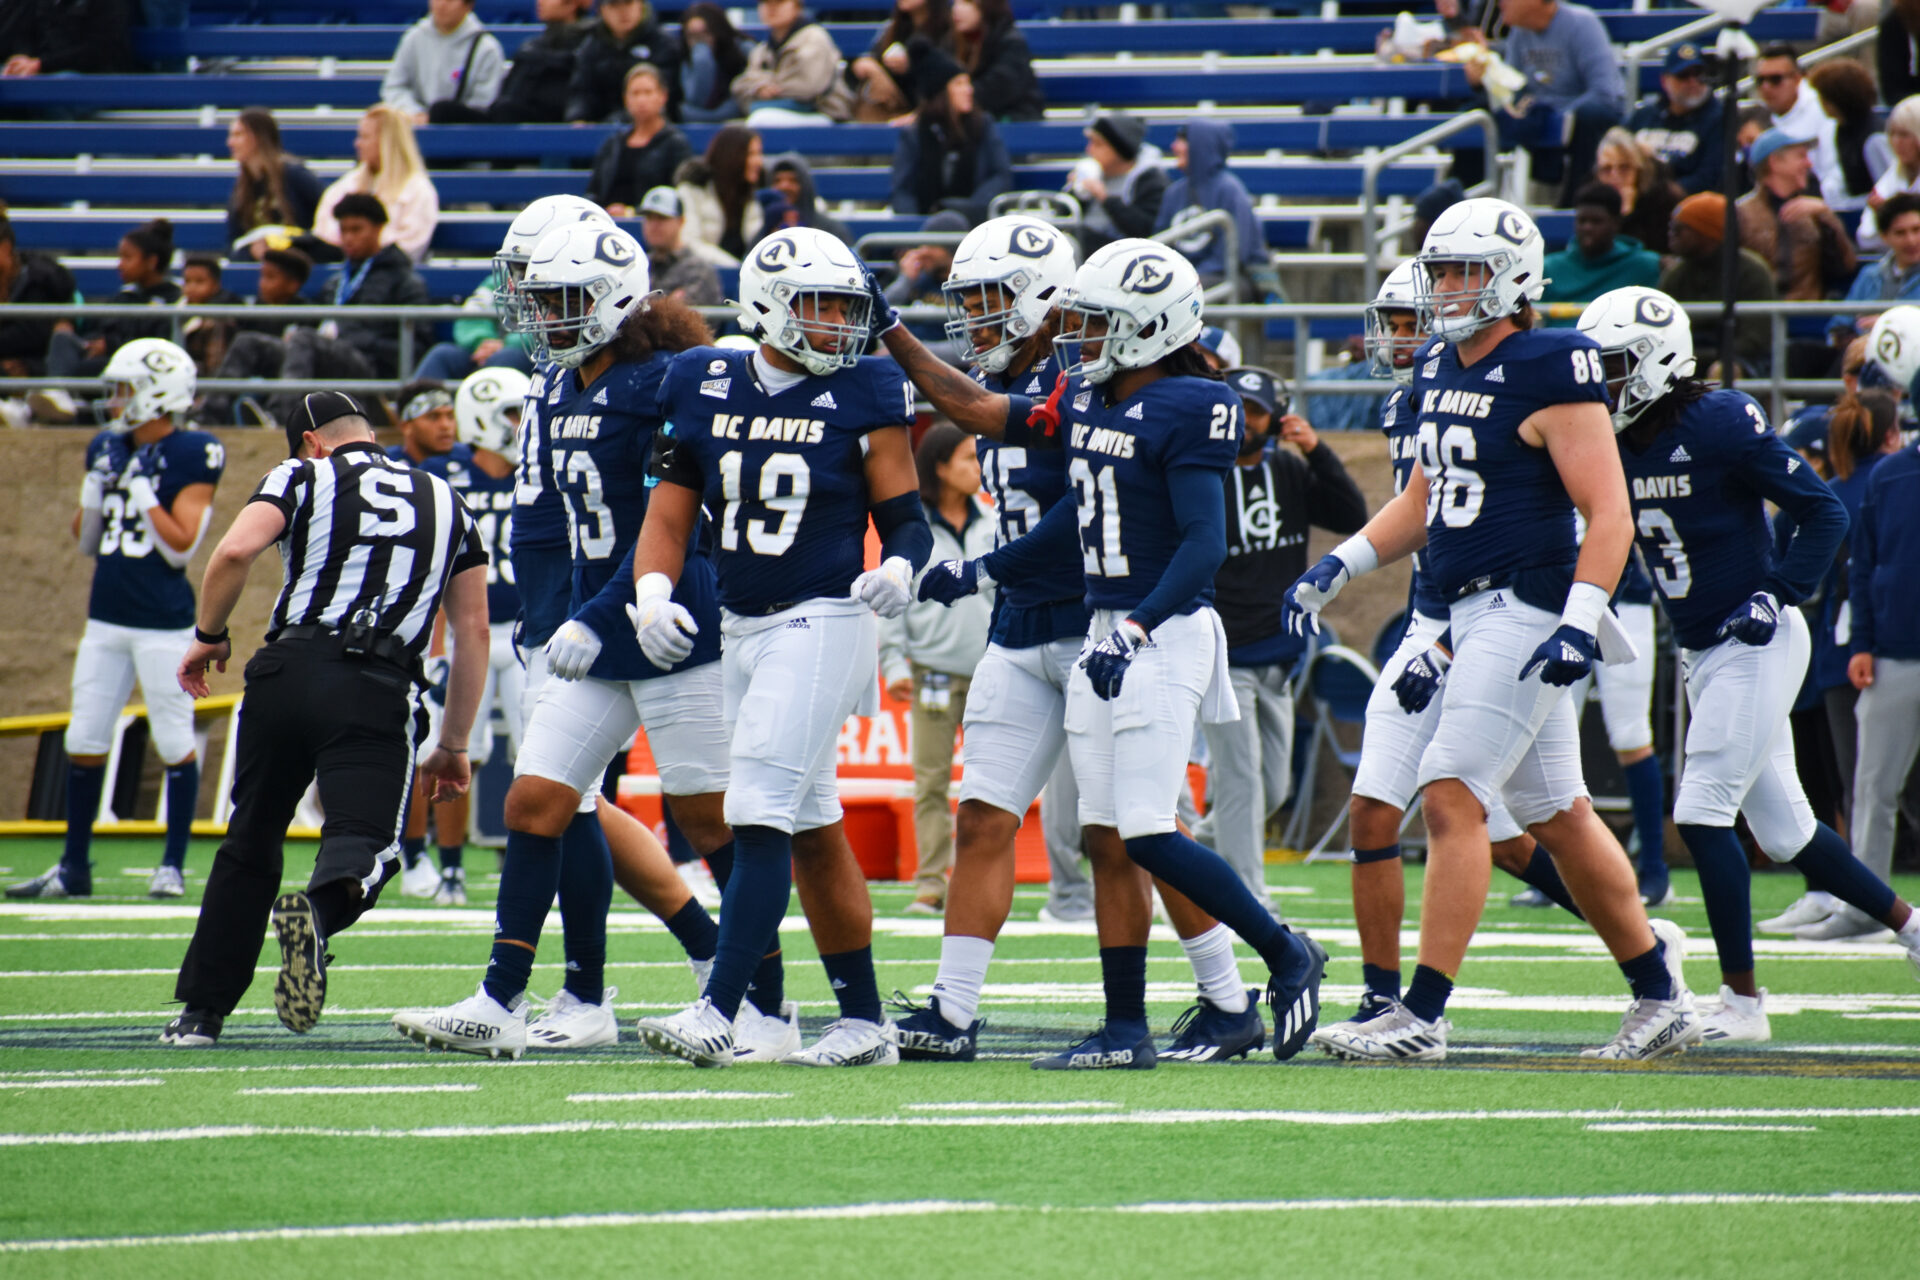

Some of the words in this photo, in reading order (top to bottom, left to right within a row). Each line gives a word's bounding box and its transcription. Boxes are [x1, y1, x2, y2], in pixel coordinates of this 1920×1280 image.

[1570, 348, 1603, 385] 86
[1437, 389, 1495, 419] DAVIS
[1745, 402, 1767, 434] 3
[561, 415, 603, 440] DAVIS
[711, 413, 744, 440] UC
[748, 416, 826, 444] DAVIS
[1208, 403, 1238, 441] 21
[1086, 427, 1136, 460] DAVIS
[359, 467, 416, 537] S
[719, 450, 811, 557] 19
[982, 446, 1041, 551] 15
[1632, 474, 1692, 500] DAVIS
[551, 450, 617, 561] 73
[1068, 457, 1130, 578] 21
[100, 493, 156, 558] 33
[1229, 533, 1305, 557] OOTBALL
[1637, 508, 1692, 599] 3
[898, 1029, 970, 1054] DIZERO
[1067, 1048, 1134, 1069] ADIZERO
